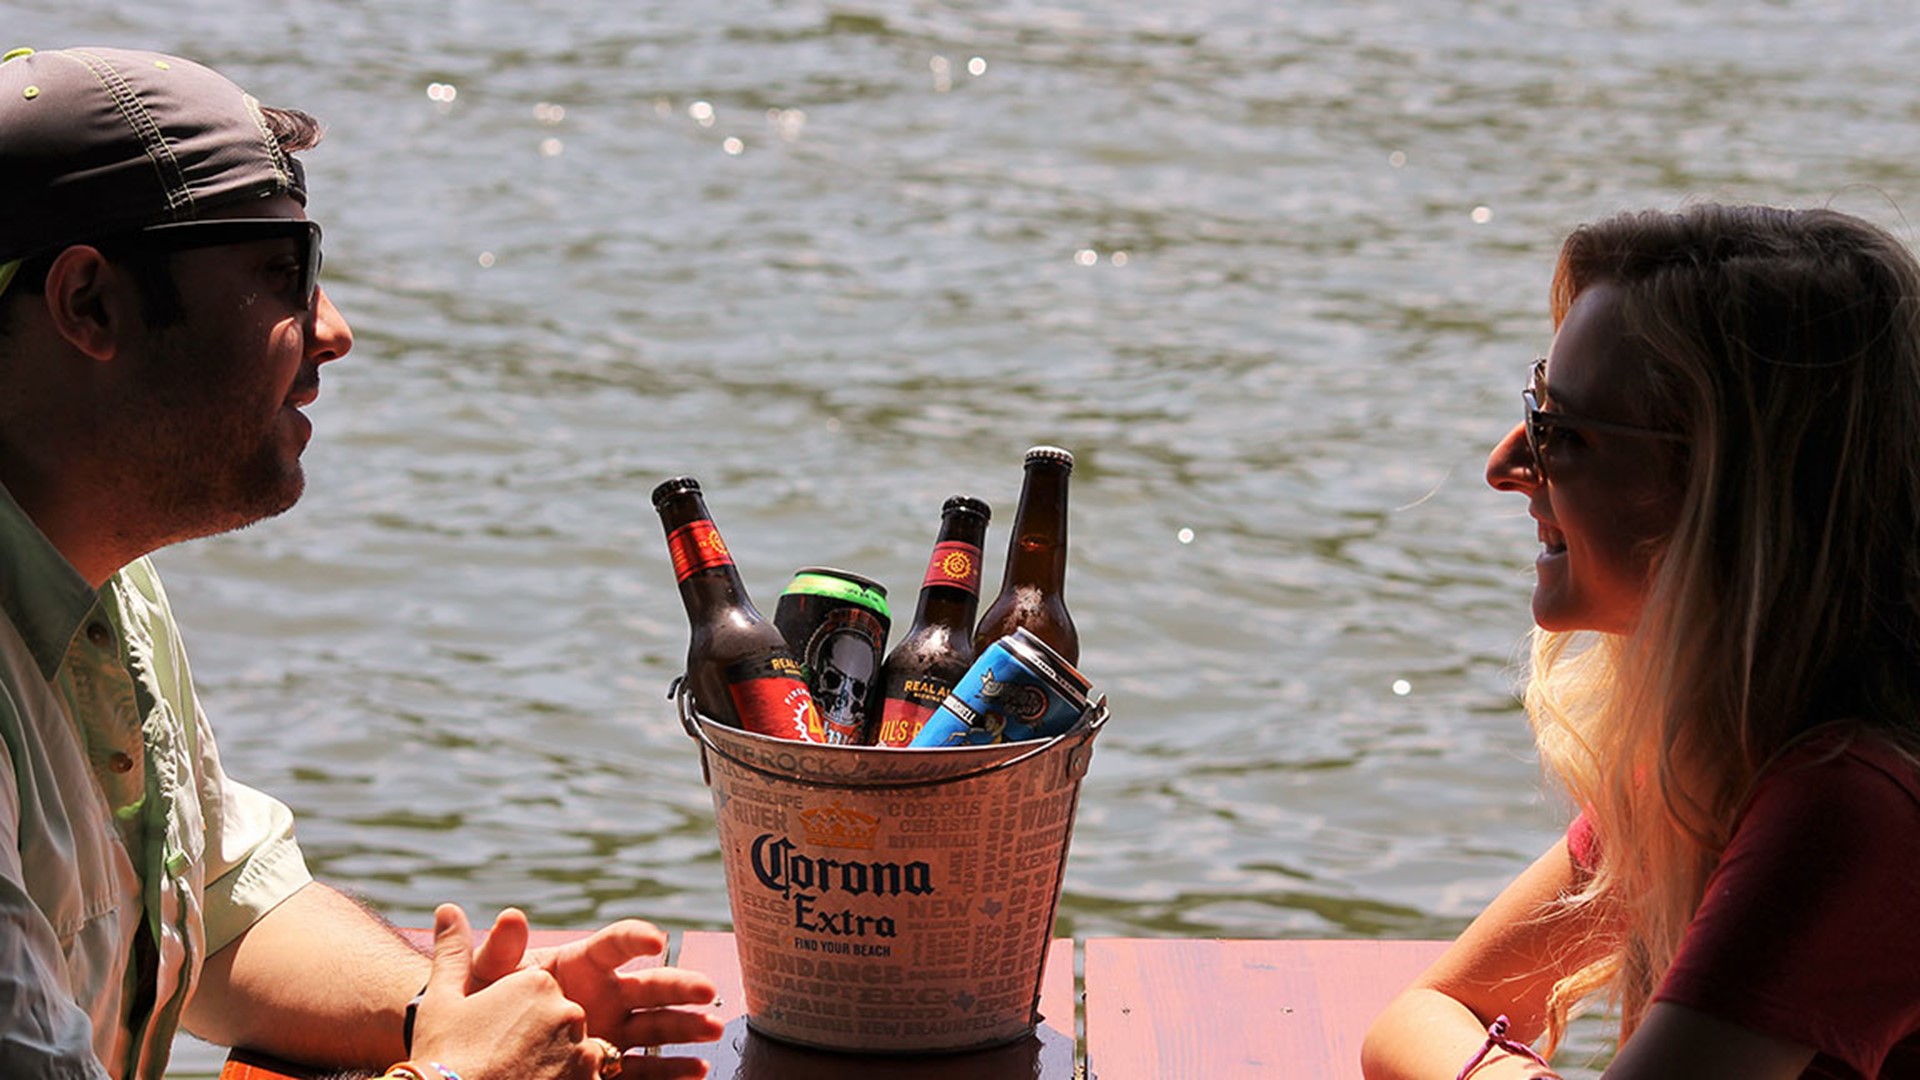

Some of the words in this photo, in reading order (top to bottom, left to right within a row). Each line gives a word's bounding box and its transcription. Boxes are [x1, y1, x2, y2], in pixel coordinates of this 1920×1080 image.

[904, 680, 936, 695] REAL
[733, 800, 789, 833] RIVER
[887, 800, 981, 818] CORPUS
[899, 818, 980, 837] CHRISTI
[751, 833, 935, 900] Corona
[793, 892, 897, 938] Extra
[907, 897, 973, 919] NEW
[794, 938, 818, 951] FIND
[821, 941, 850, 955] YOUR
[853, 944, 892, 957] BEACH
[753, 947, 903, 984] SUNDANCE
[857, 987, 954, 1005] BIG
